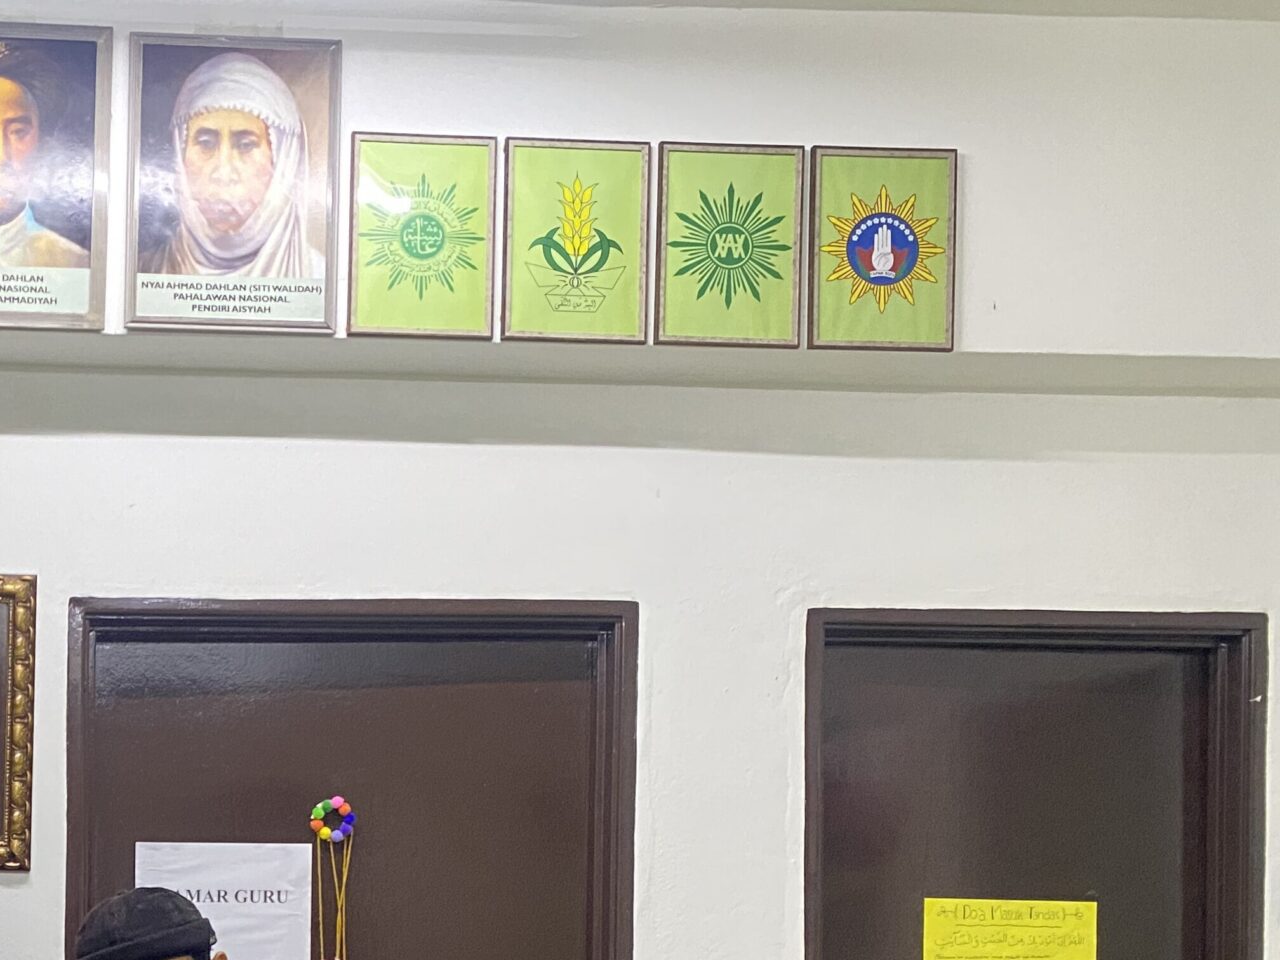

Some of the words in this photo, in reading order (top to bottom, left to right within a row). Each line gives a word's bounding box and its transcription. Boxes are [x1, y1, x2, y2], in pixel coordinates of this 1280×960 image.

[2, 274, 44, 283] DAHLAN
[141, 281, 164, 290] NYAI
[166, 282, 203, 291] AHMAD
[205, 283, 247, 292] DAHLAN
[249, 284, 271, 293] (SITI
[273, 285, 322, 294] WALIDAH)
[173, 293, 236, 302] PAHALAWAN
[238, 294, 291, 303] NASIONAL
[191, 304, 230, 313] PENDIRI
[232, 305, 272, 314] AISYIAH
[176, 889, 230, 903] MAR
[234, 889, 289, 904] GURU
